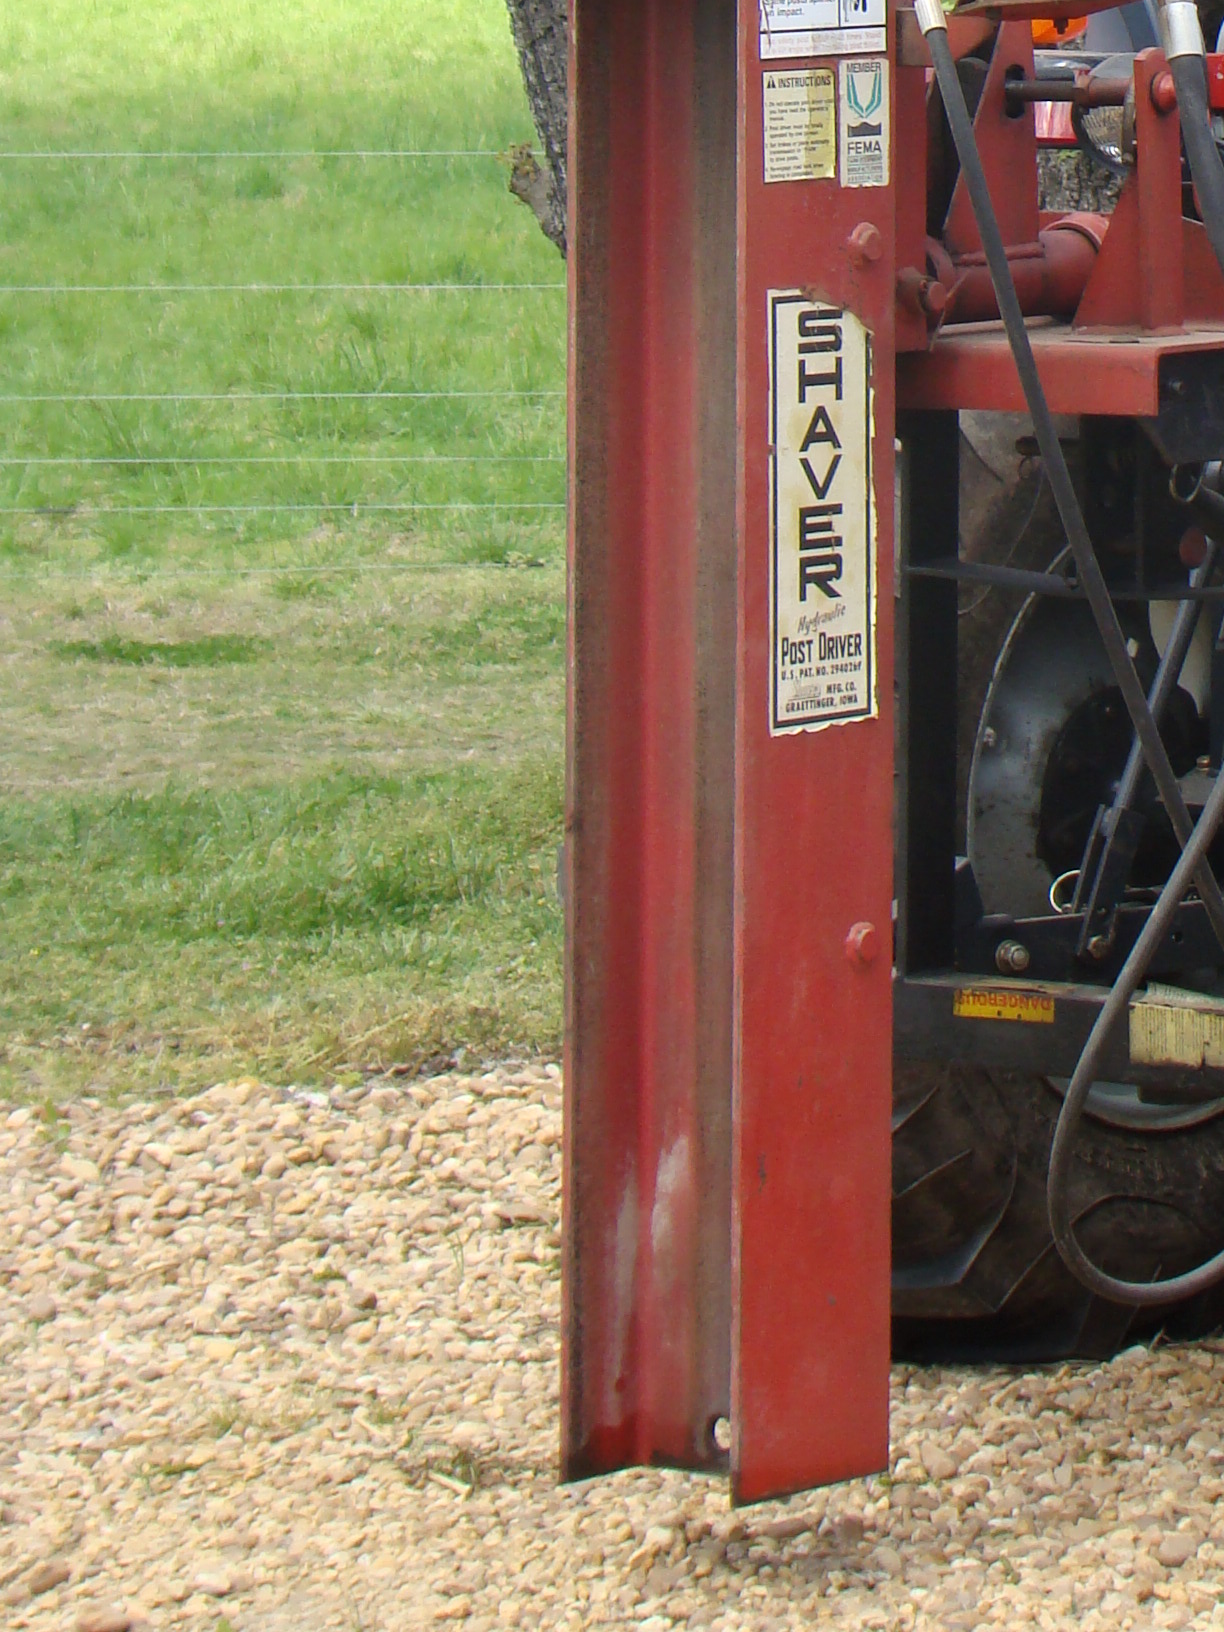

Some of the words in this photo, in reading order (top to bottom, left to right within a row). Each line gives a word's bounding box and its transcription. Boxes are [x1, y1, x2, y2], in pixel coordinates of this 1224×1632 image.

[778, 75, 832, 89] INSTRUCTIONS
[848, 140, 882, 155] FEMA
[798, 308, 843, 602] SHAVER
[839, 694, 858, 705] IOWA
